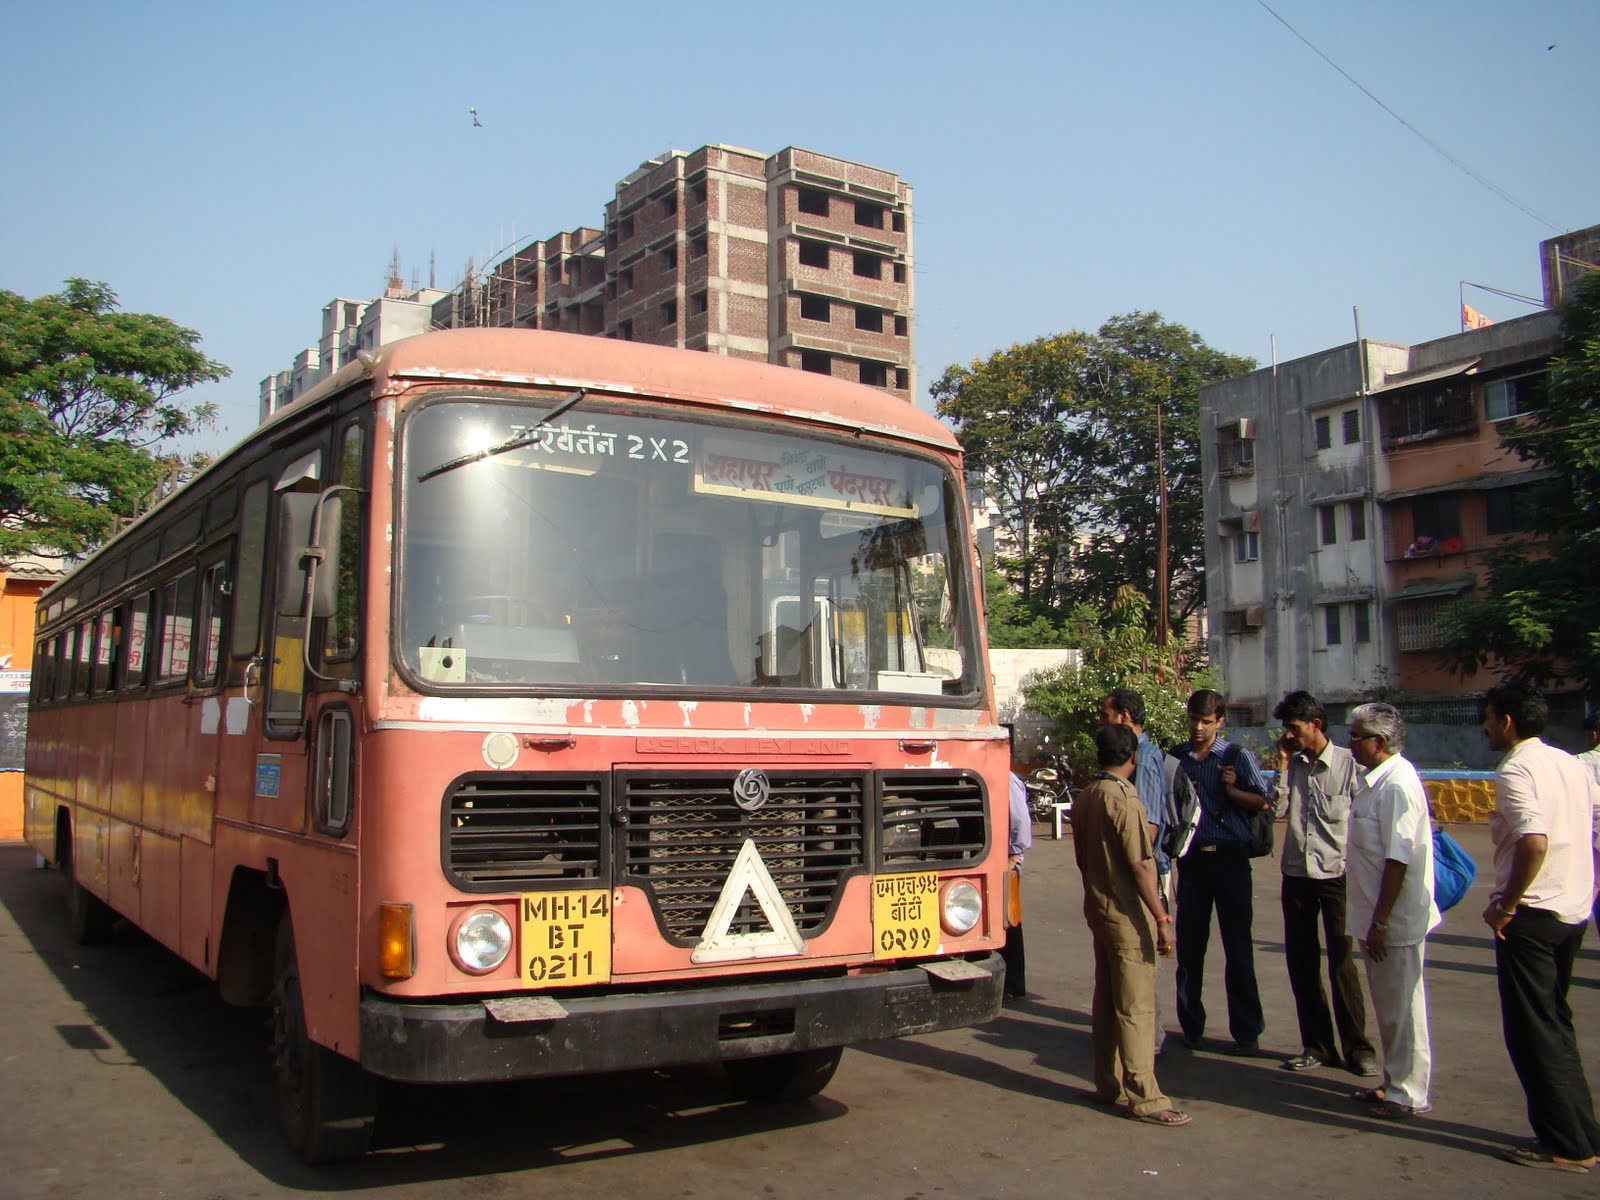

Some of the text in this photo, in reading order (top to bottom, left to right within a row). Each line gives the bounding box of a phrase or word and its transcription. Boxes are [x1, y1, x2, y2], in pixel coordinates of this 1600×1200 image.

[628, 434, 689, 464] 2X2
[646, 738, 850, 754] ASHOK LEYLAND
[891, 896, 922, 922] बीटी
[549, 923, 585, 950] BT
[529, 950, 593, 981] 0211
